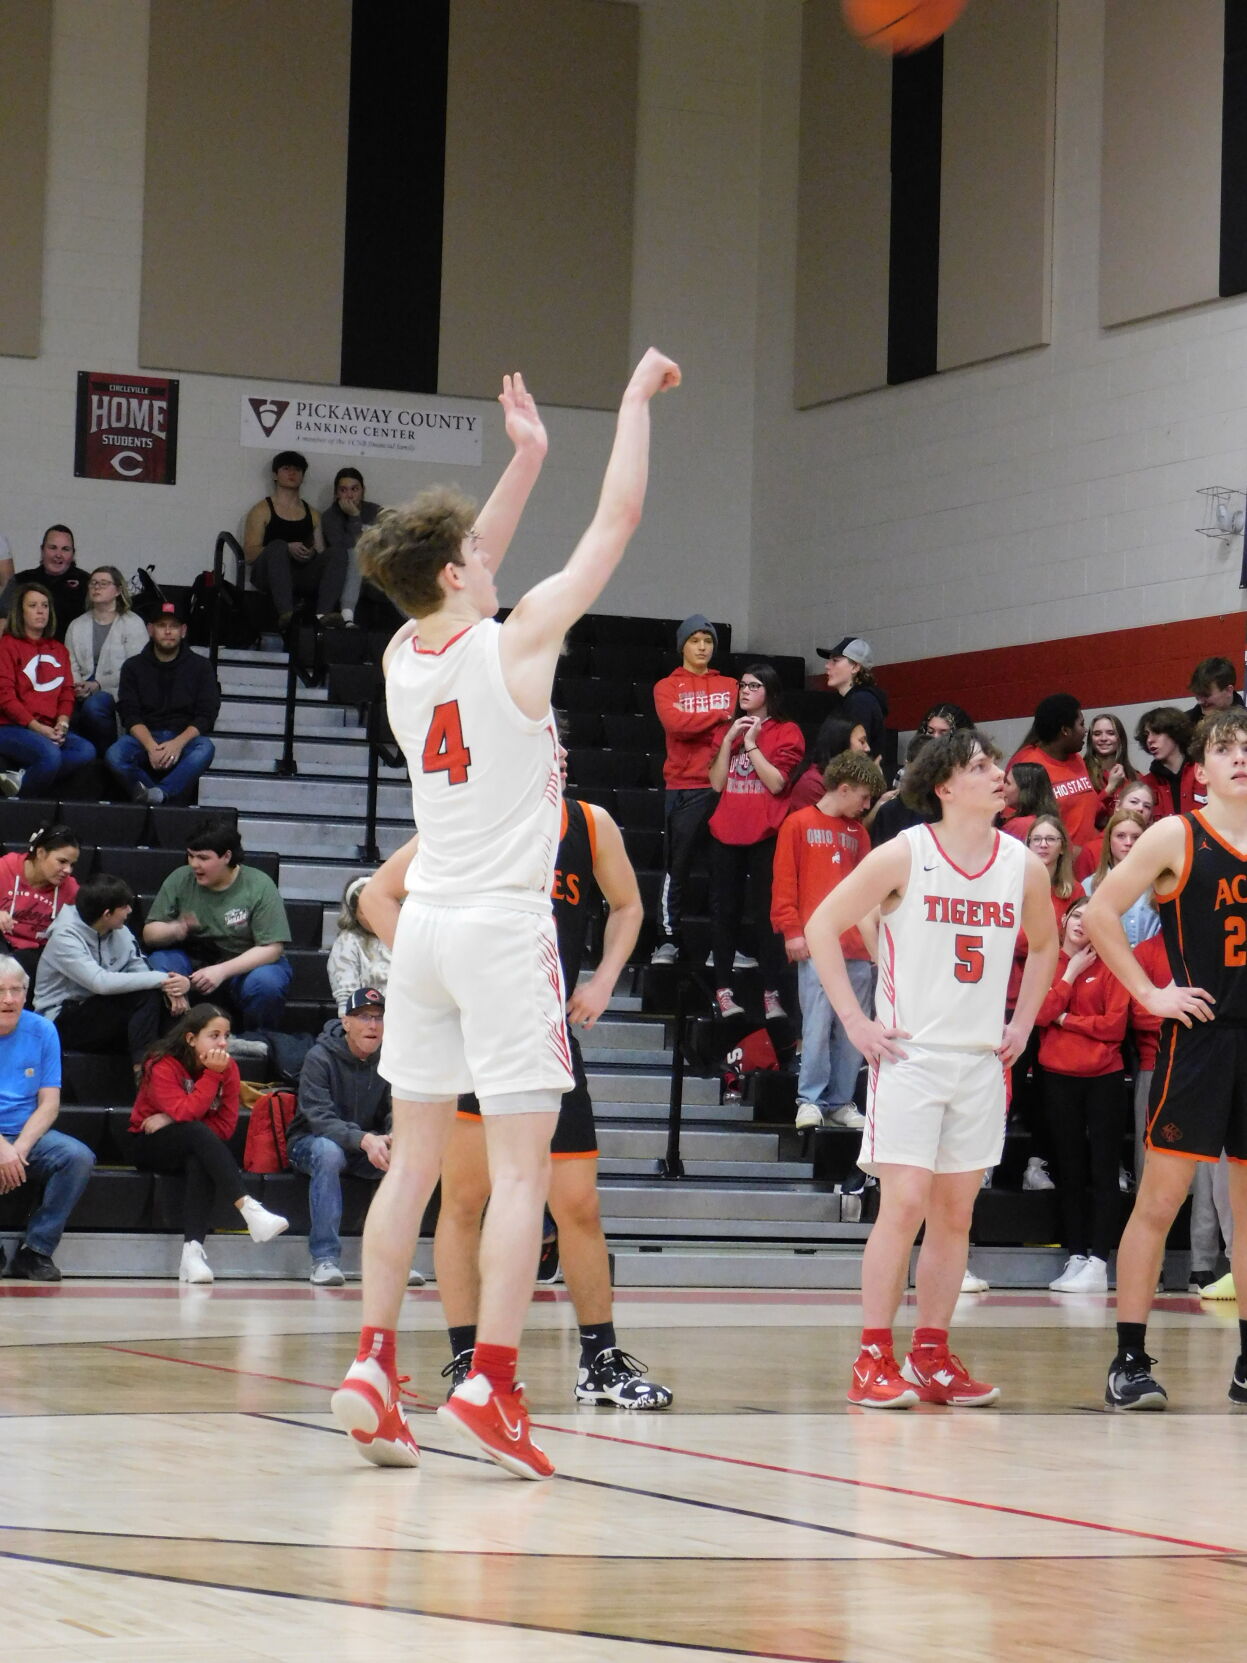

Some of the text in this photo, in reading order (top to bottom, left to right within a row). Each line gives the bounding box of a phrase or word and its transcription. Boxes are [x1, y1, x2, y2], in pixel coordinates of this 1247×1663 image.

[109, 384, 149, 394] CIRCLEVILLE
[90, 394, 168, 440] HOME
[295, 421, 416, 441] BANKING CENTER
[296, 402, 477, 431] PICKAWAY COUNTY
[102, 434, 153, 448] STUDENTS
[22, 653, 65, 692] C
[421, 698, 472, 786] 4
[1052, 776, 1092, 799] HIO STATE
[550, 869, 580, 906] ES
[923, 894, 1015, 929] TIGERS
[954, 933, 985, 984] 5
[1224, 915, 1247, 967] 2
